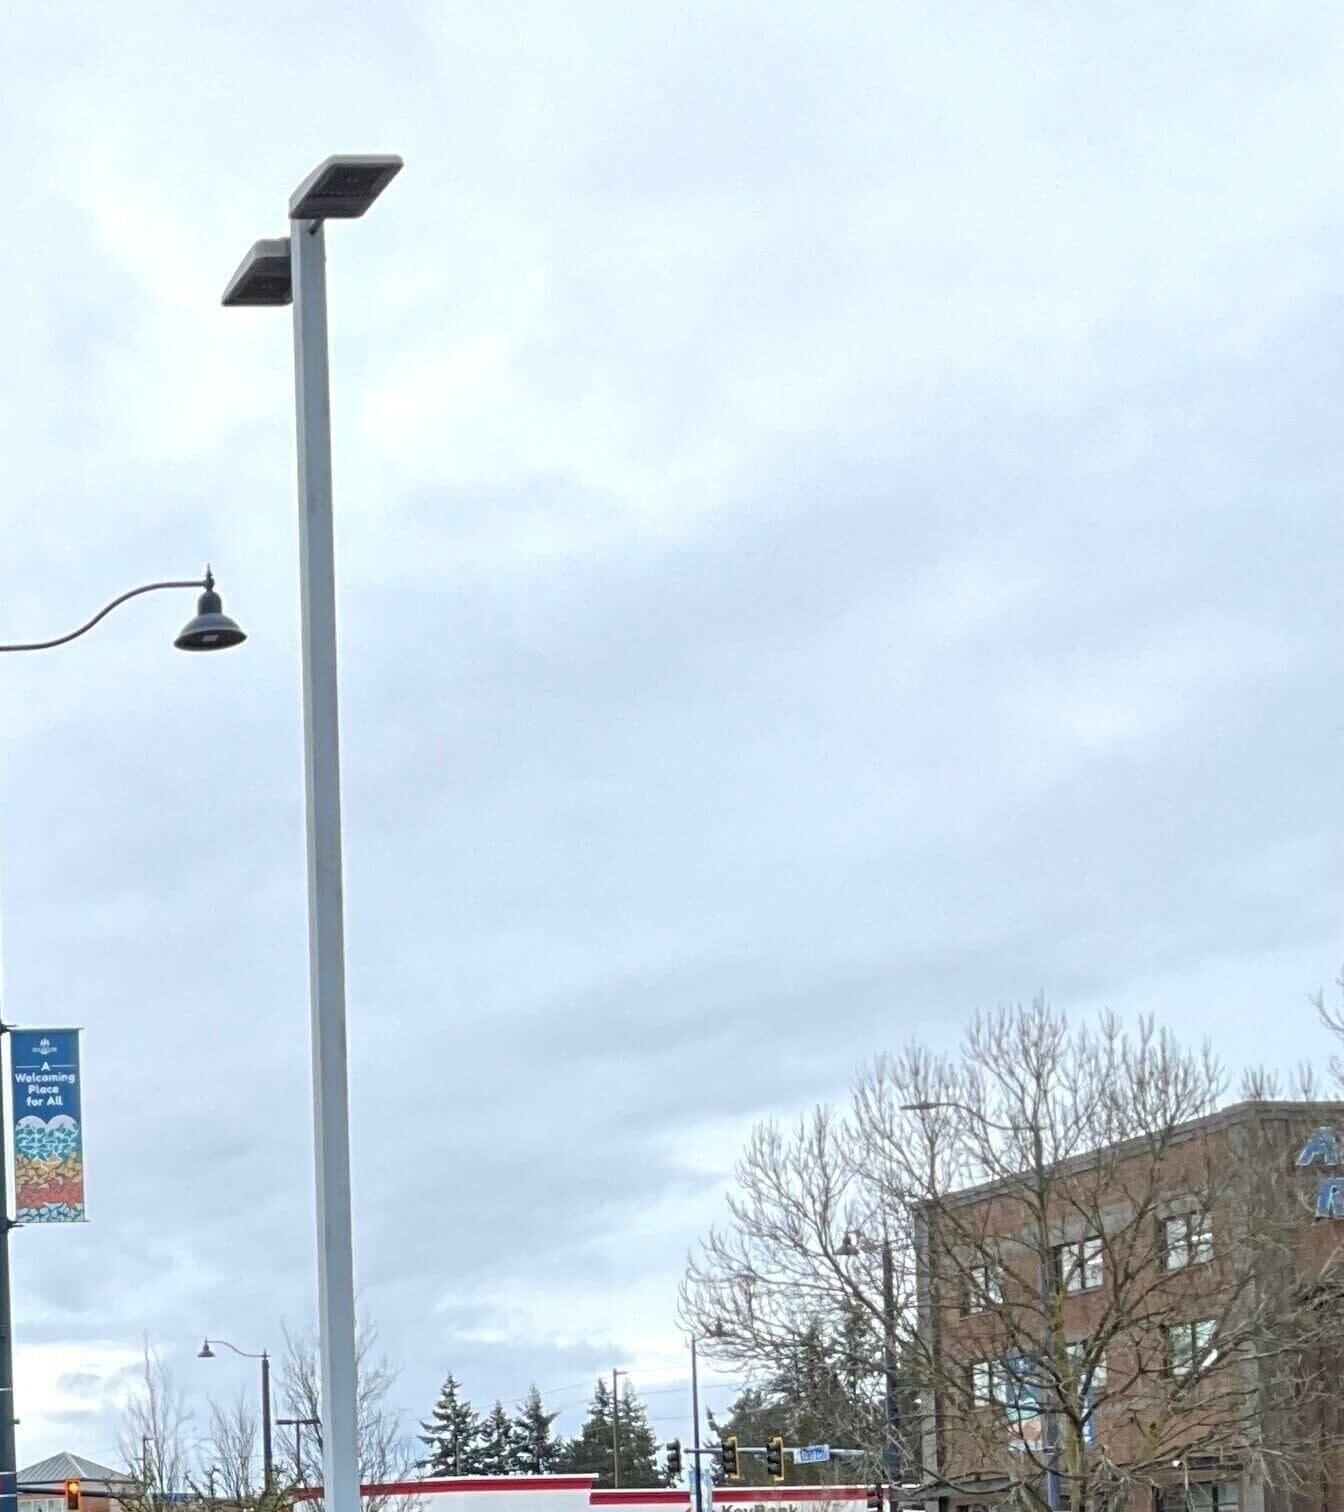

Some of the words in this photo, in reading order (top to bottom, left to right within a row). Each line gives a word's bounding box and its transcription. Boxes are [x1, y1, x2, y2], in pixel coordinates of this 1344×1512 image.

[41, 1061, 50, 1071] A
[15, 1072, 75, 1084] Welcoming
[28, 1084, 59, 1094] Place
[26, 1096, 44, 1106] for
[47, 1095, 63, 1106] All
